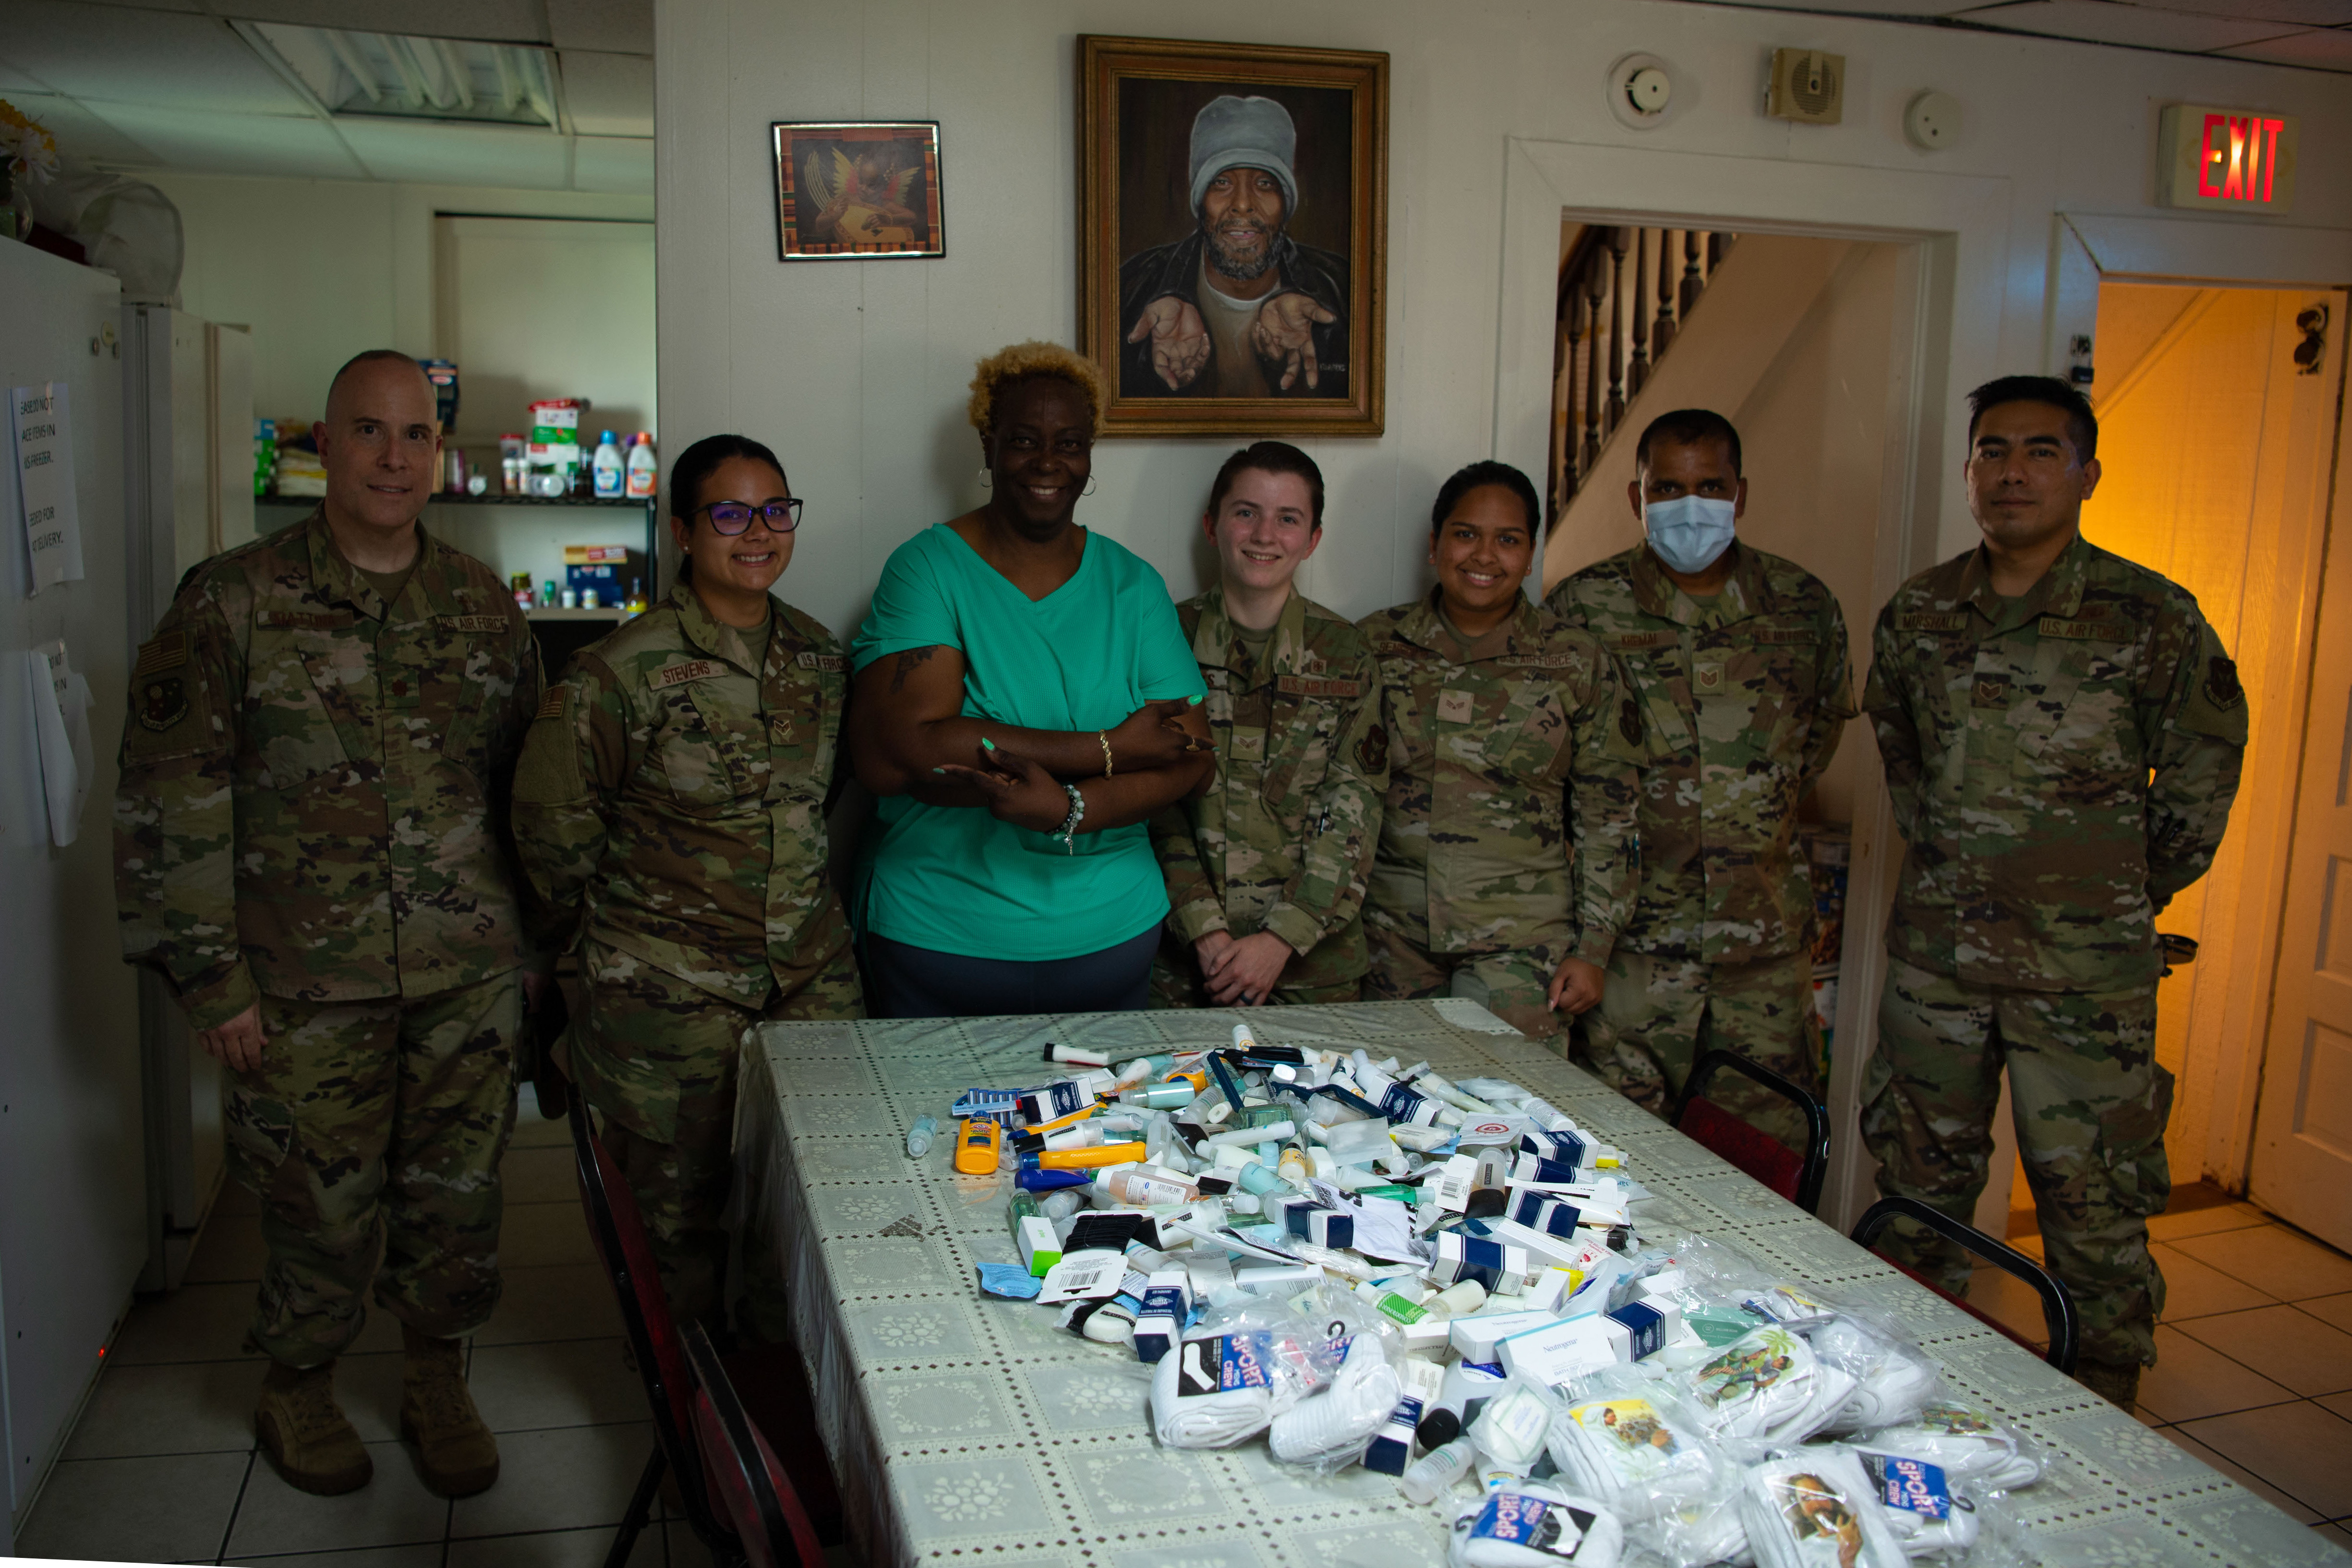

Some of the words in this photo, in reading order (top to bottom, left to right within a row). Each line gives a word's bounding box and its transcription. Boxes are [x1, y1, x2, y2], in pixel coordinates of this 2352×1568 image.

[2199, 113, 2284, 202] EXIT
[39, 397, 54, 410] NOT
[33, 424, 46, 440] ITEMS
[47, 423, 55, 436] IN
[31, 450, 53, 467] FREEZER.
[43, 506, 54, 521] FOR
[37, 531, 63, 551] DELIVERY.
[459, 617, 476, 630] AIR
[476, 617, 505, 630] FORCE
[1903, 615, 1958, 630] MARSHALL
[2041, 620, 2062, 635] U.S.
[2065, 623, 2086, 637] AIR
[2089, 624, 2128, 639] FORCE
[1774, 630, 1785, 641] AIR
[1787, 629, 1815, 642] FORCE
[822, 657, 850, 671] FORCE
[1520, 655, 1536, 663] AIR
[1537, 654, 1571, 666] FORCE
[663, 661, 711, 684] STEVENS
[1282, 676, 1300, 692] U.S.
[1304, 681, 1319, 693] AIR
[1323, 681, 1360, 695] FORCE
[1382, 1304, 1411, 1324] CONDITIONER
[1231, 1337, 1265, 1387] SPORT
[1223, 1360, 1234, 1387] CREW
[1888, 1479, 1900, 1506] CREW
[1896, 1460, 1939, 1516] SPORT
[1495, 1494, 1520, 1539] SPORT
[1523, 1500, 1544, 1525] CREW
